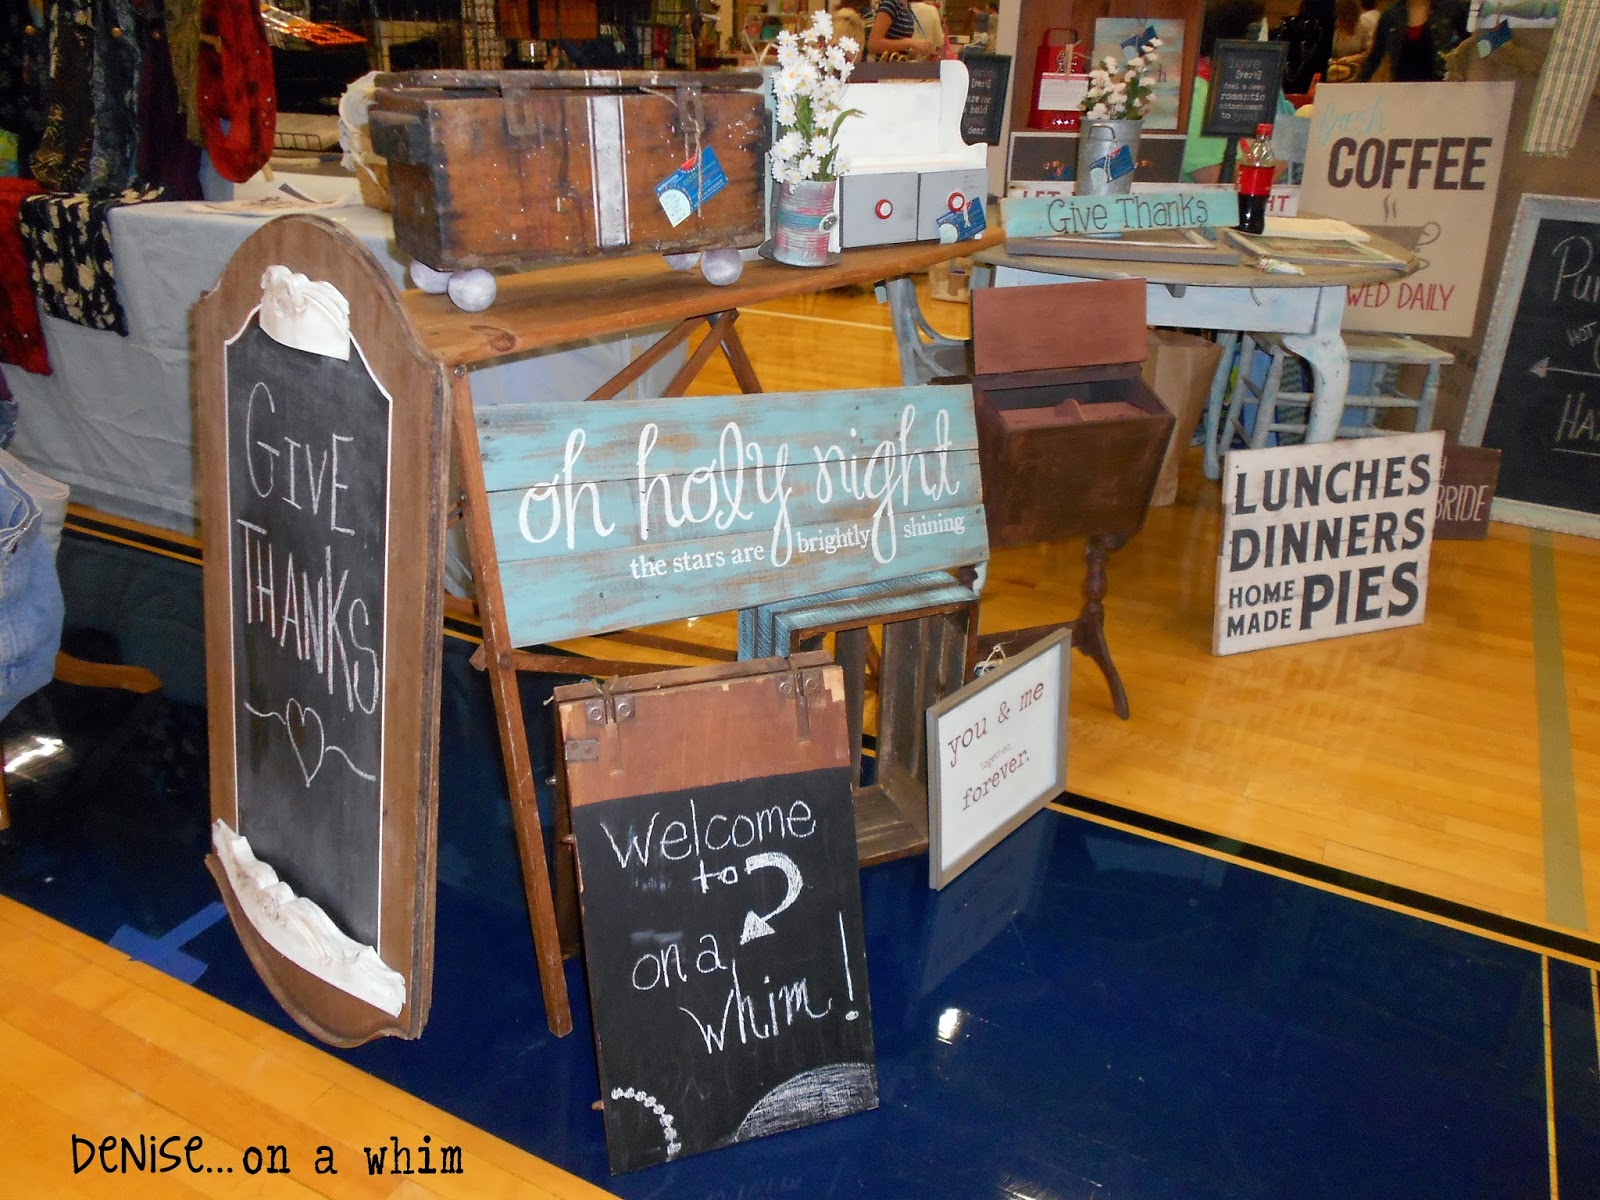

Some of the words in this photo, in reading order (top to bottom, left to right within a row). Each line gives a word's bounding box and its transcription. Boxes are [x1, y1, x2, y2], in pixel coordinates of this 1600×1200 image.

[1220, 92, 1266, 101] romantic
[1327, 137, 1493, 191] COFFEE
[1047, 198, 1108, 233] Give
[1115, 193, 1209, 229] Thanks
[1397, 282, 1456, 311] DAILY
[246, 382, 355, 536] GIVE
[519, 428, 615, 550] oh
[637, 421, 793, 568] holy
[813, 404, 961, 564] night
[1233, 453, 1432, 516] LUNCHES
[1435, 484, 1489, 522] BRIDE
[630, 555, 668, 580] the
[673, 548, 726, 573] stars
[732, 544, 765, 566] are
[798, 527, 872, 558] brightly
[903, 512, 966, 538] shining
[1229, 507, 1426, 573] DINNERS
[236, 518, 379, 715] THANKS
[1226, 608, 1293, 638] MADE
[1228, 579, 1295, 609] HOME
[1299, 561, 1419, 631] PIES
[947, 717, 988, 768] you
[997, 701, 1011, 724] &
[1019, 682, 1044, 712] me
[962, 749, 1031, 811] forever.
[600, 799, 816, 869] Welcome
[692, 860, 738, 893] to
[631, 943, 687, 991] on
[696, 934, 728, 974] a
